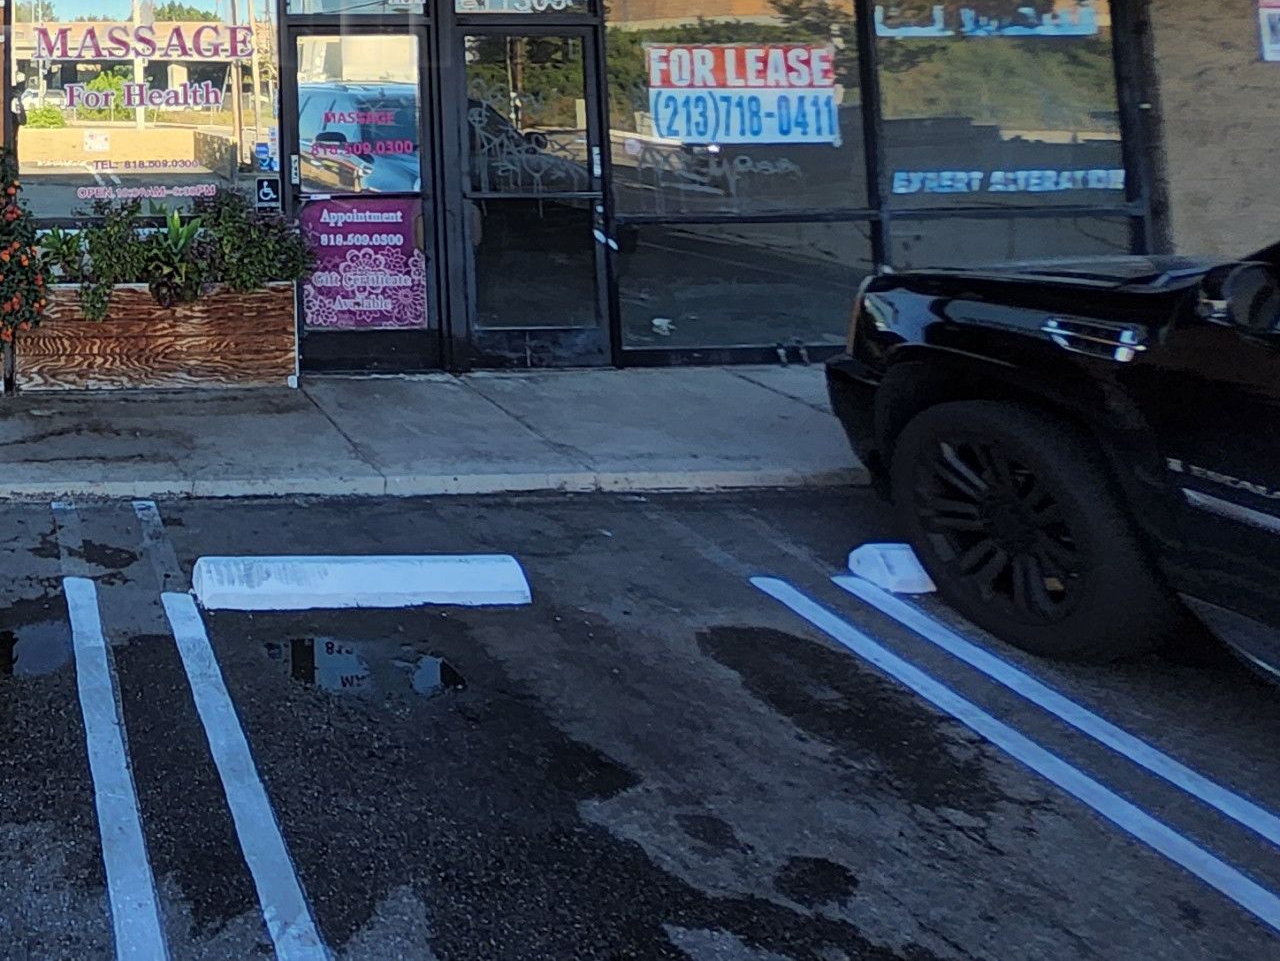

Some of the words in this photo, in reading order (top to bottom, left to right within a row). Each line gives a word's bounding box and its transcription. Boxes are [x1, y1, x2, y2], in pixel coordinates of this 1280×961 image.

[33, 25, 255, 60] MASSAGE
[651, 48, 717, 86] FOR
[724, 48, 835, 86] LEASE
[64, 83, 115, 108] For
[123, 80, 222, 107] Health
[324, 111, 393, 124] MASSAGE
[320, 209, 403, 226] Appointment
[320, 233, 404, 246] 818.509.0300
[312, 271, 341, 287] Gift
[342, 271, 412, 291] Certificate
[333, 295, 392, 311] Available
